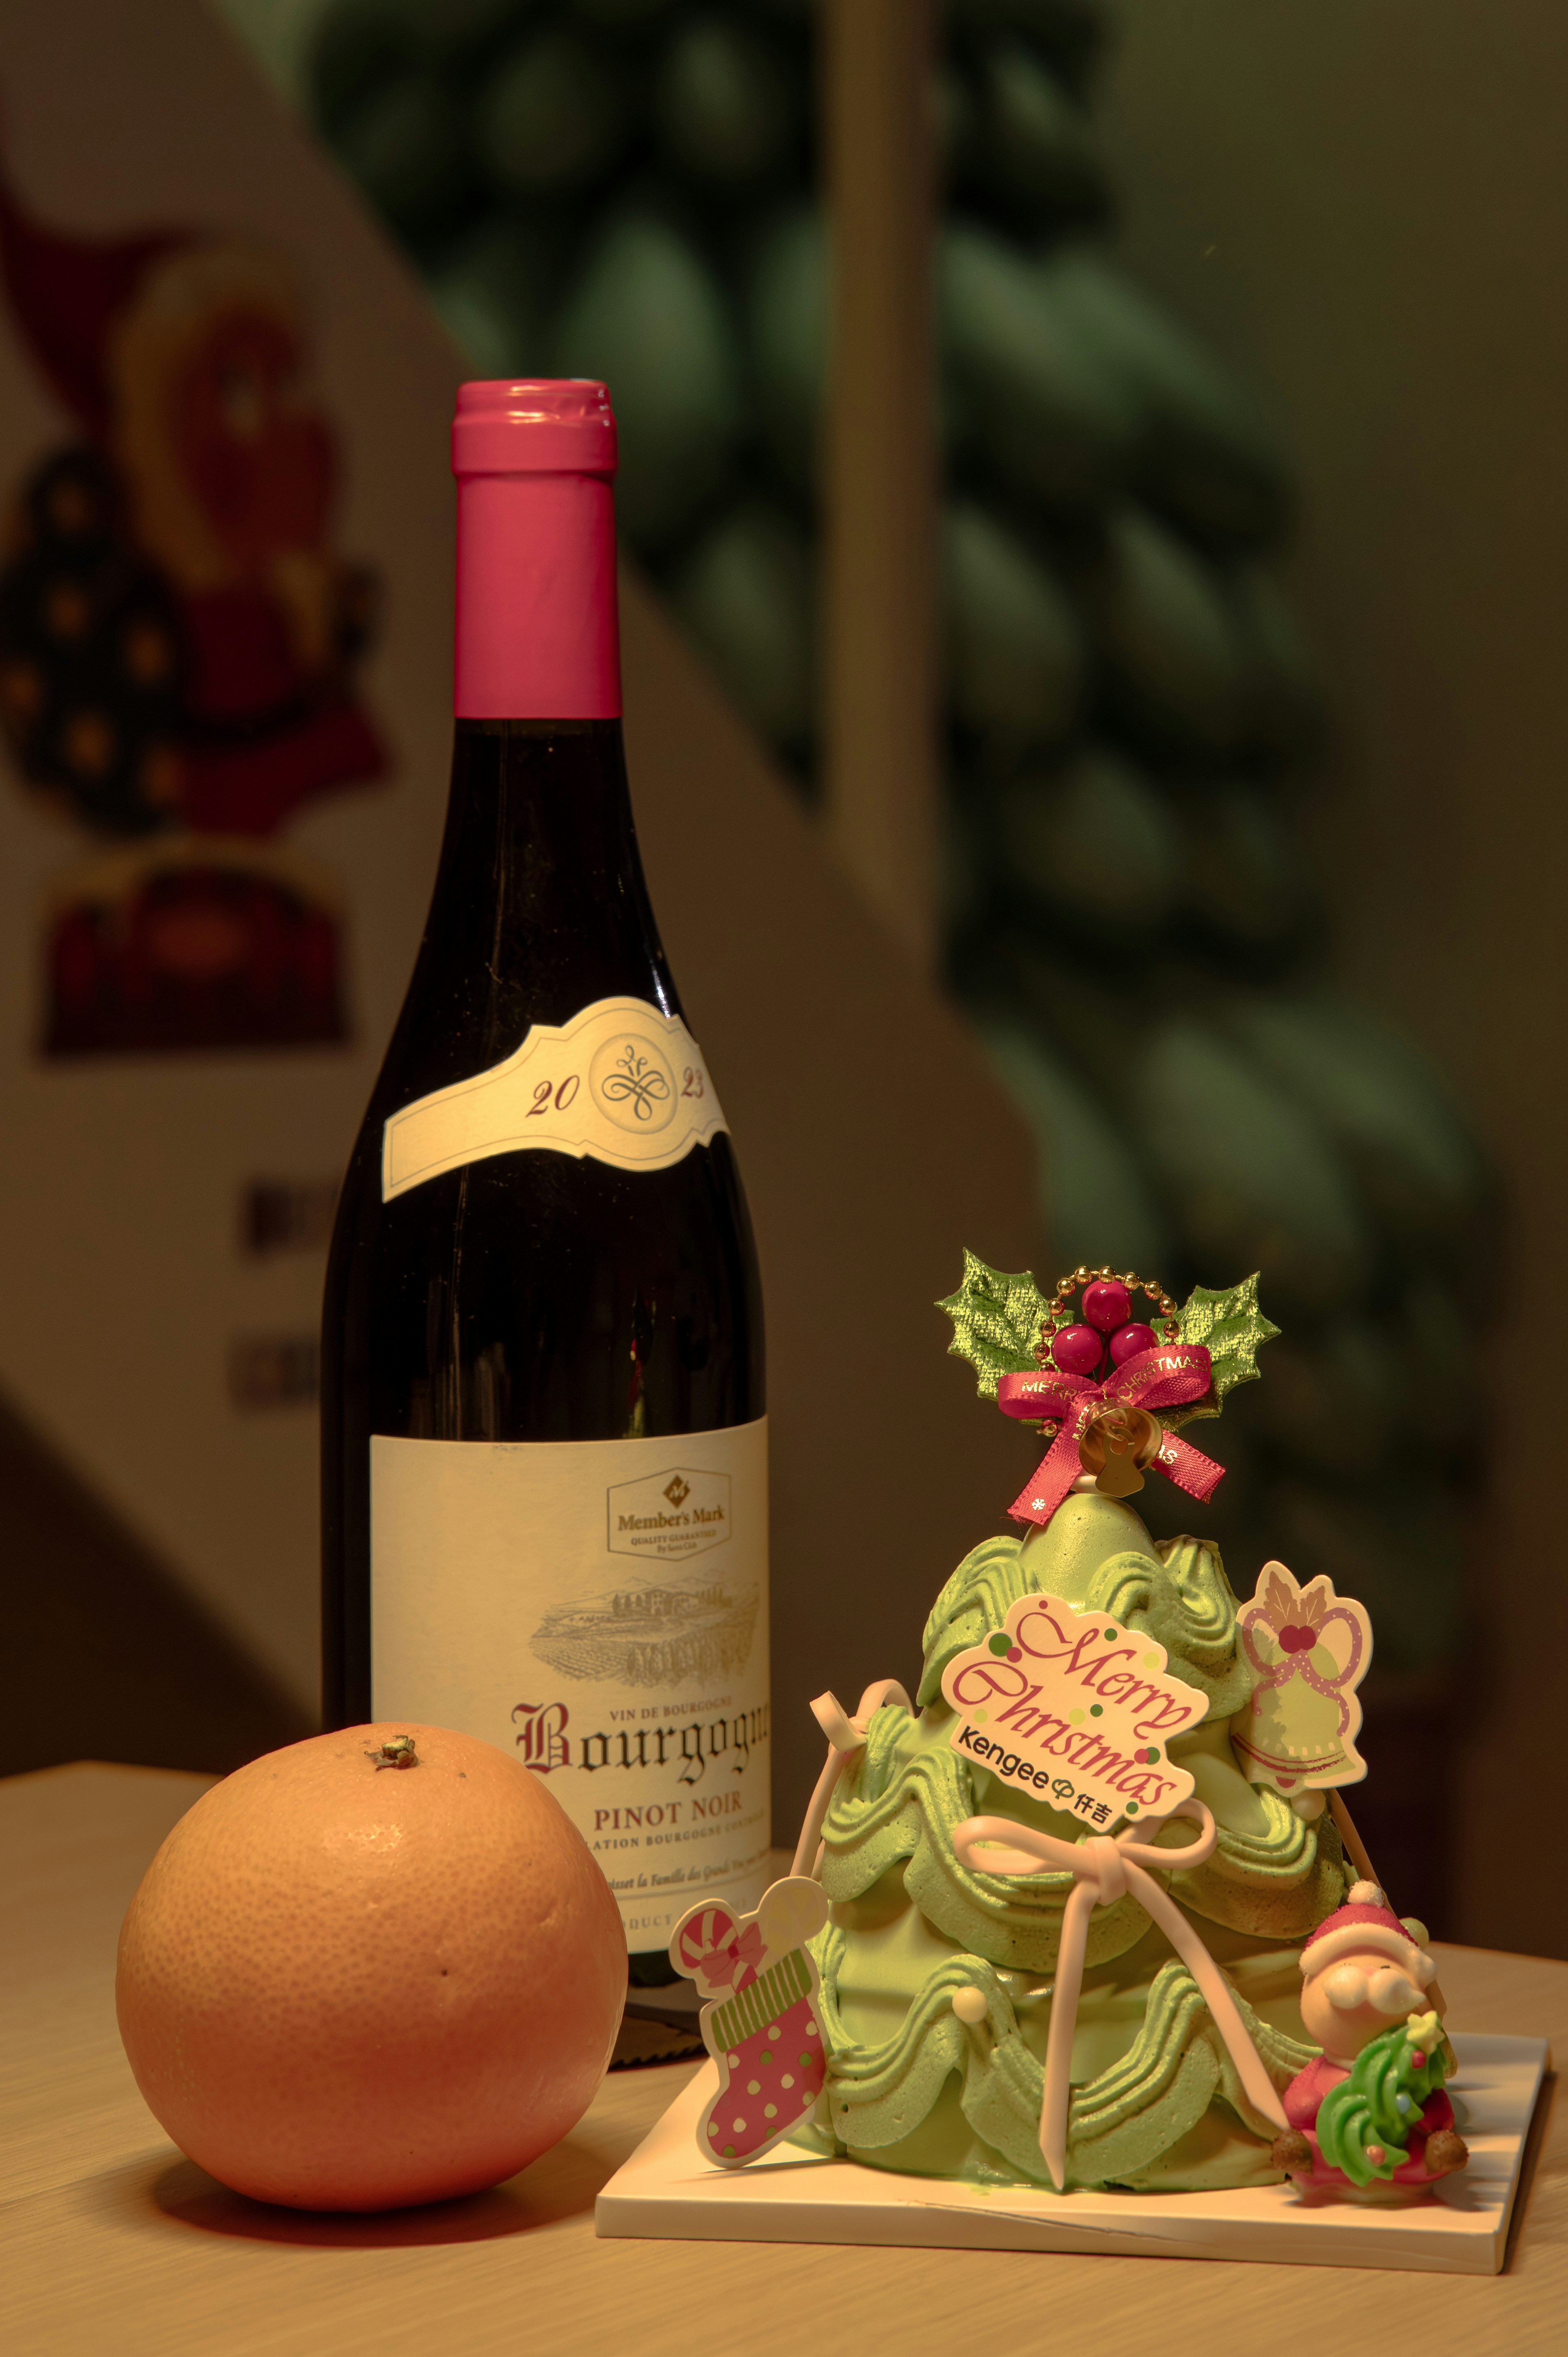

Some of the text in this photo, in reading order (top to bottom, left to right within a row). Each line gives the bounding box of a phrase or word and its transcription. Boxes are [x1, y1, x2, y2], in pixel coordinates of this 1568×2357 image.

[525, 1067, 704, 1118] 20 23
[1022, 1356, 1208, 1402] MERR CHRISTMAS
[618, 1504, 725, 1531] Member's Mark
[631, 1535, 668, 1546] QUALITY
[1016, 1612, 1192, 1740] Merry
[610, 1695, 732, 1722] VIN DE BOURGOGNE
[953, 1661, 1177, 1805] Christmas
[595, 1802, 682, 1830] PINOT
[692, 1790, 742, 1821] NOIR
[1074, 1793, 1113, 1824] 仟吉
[646, 1825, 720, 1846] BOURGOGNE
